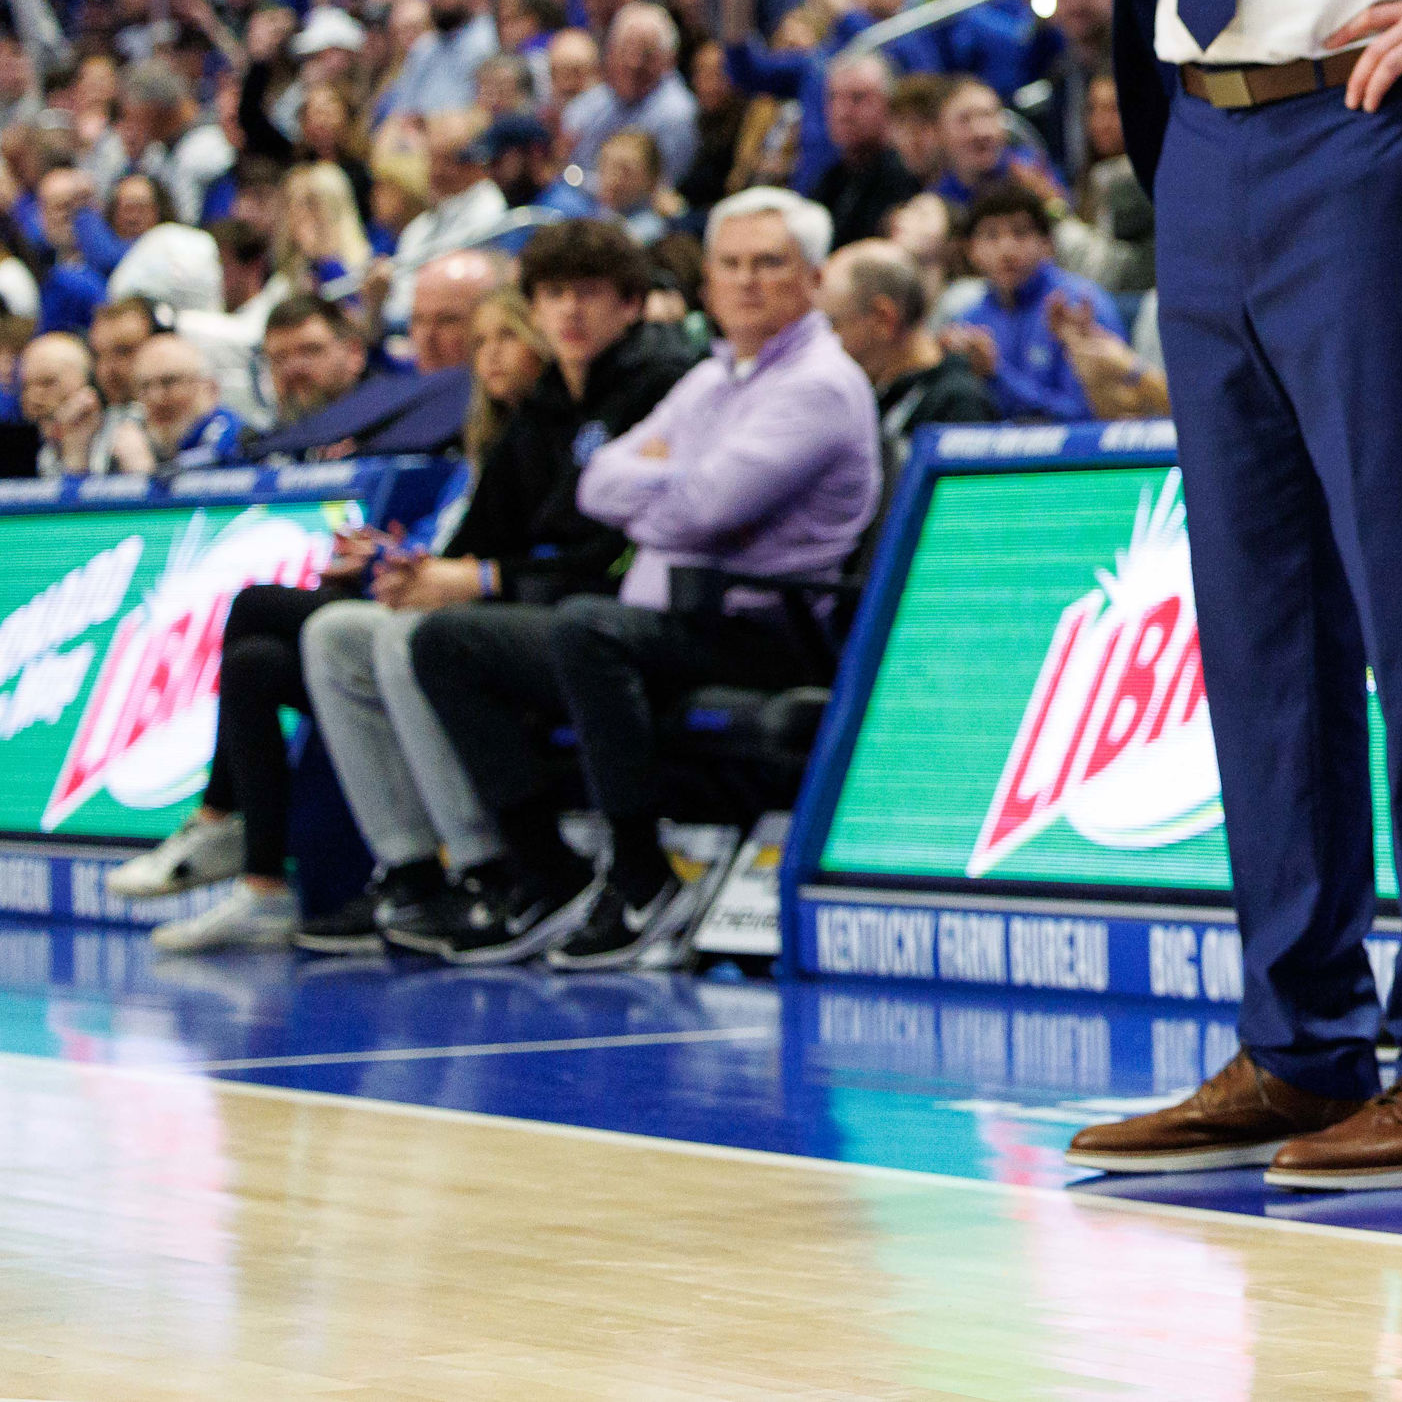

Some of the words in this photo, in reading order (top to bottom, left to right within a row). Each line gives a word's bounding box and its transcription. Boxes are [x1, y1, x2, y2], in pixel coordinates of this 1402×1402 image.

[938, 910, 1007, 983] FARM
[1009, 915, 1110, 992] BUREAU
[1149, 925, 1198, 999] BIG
